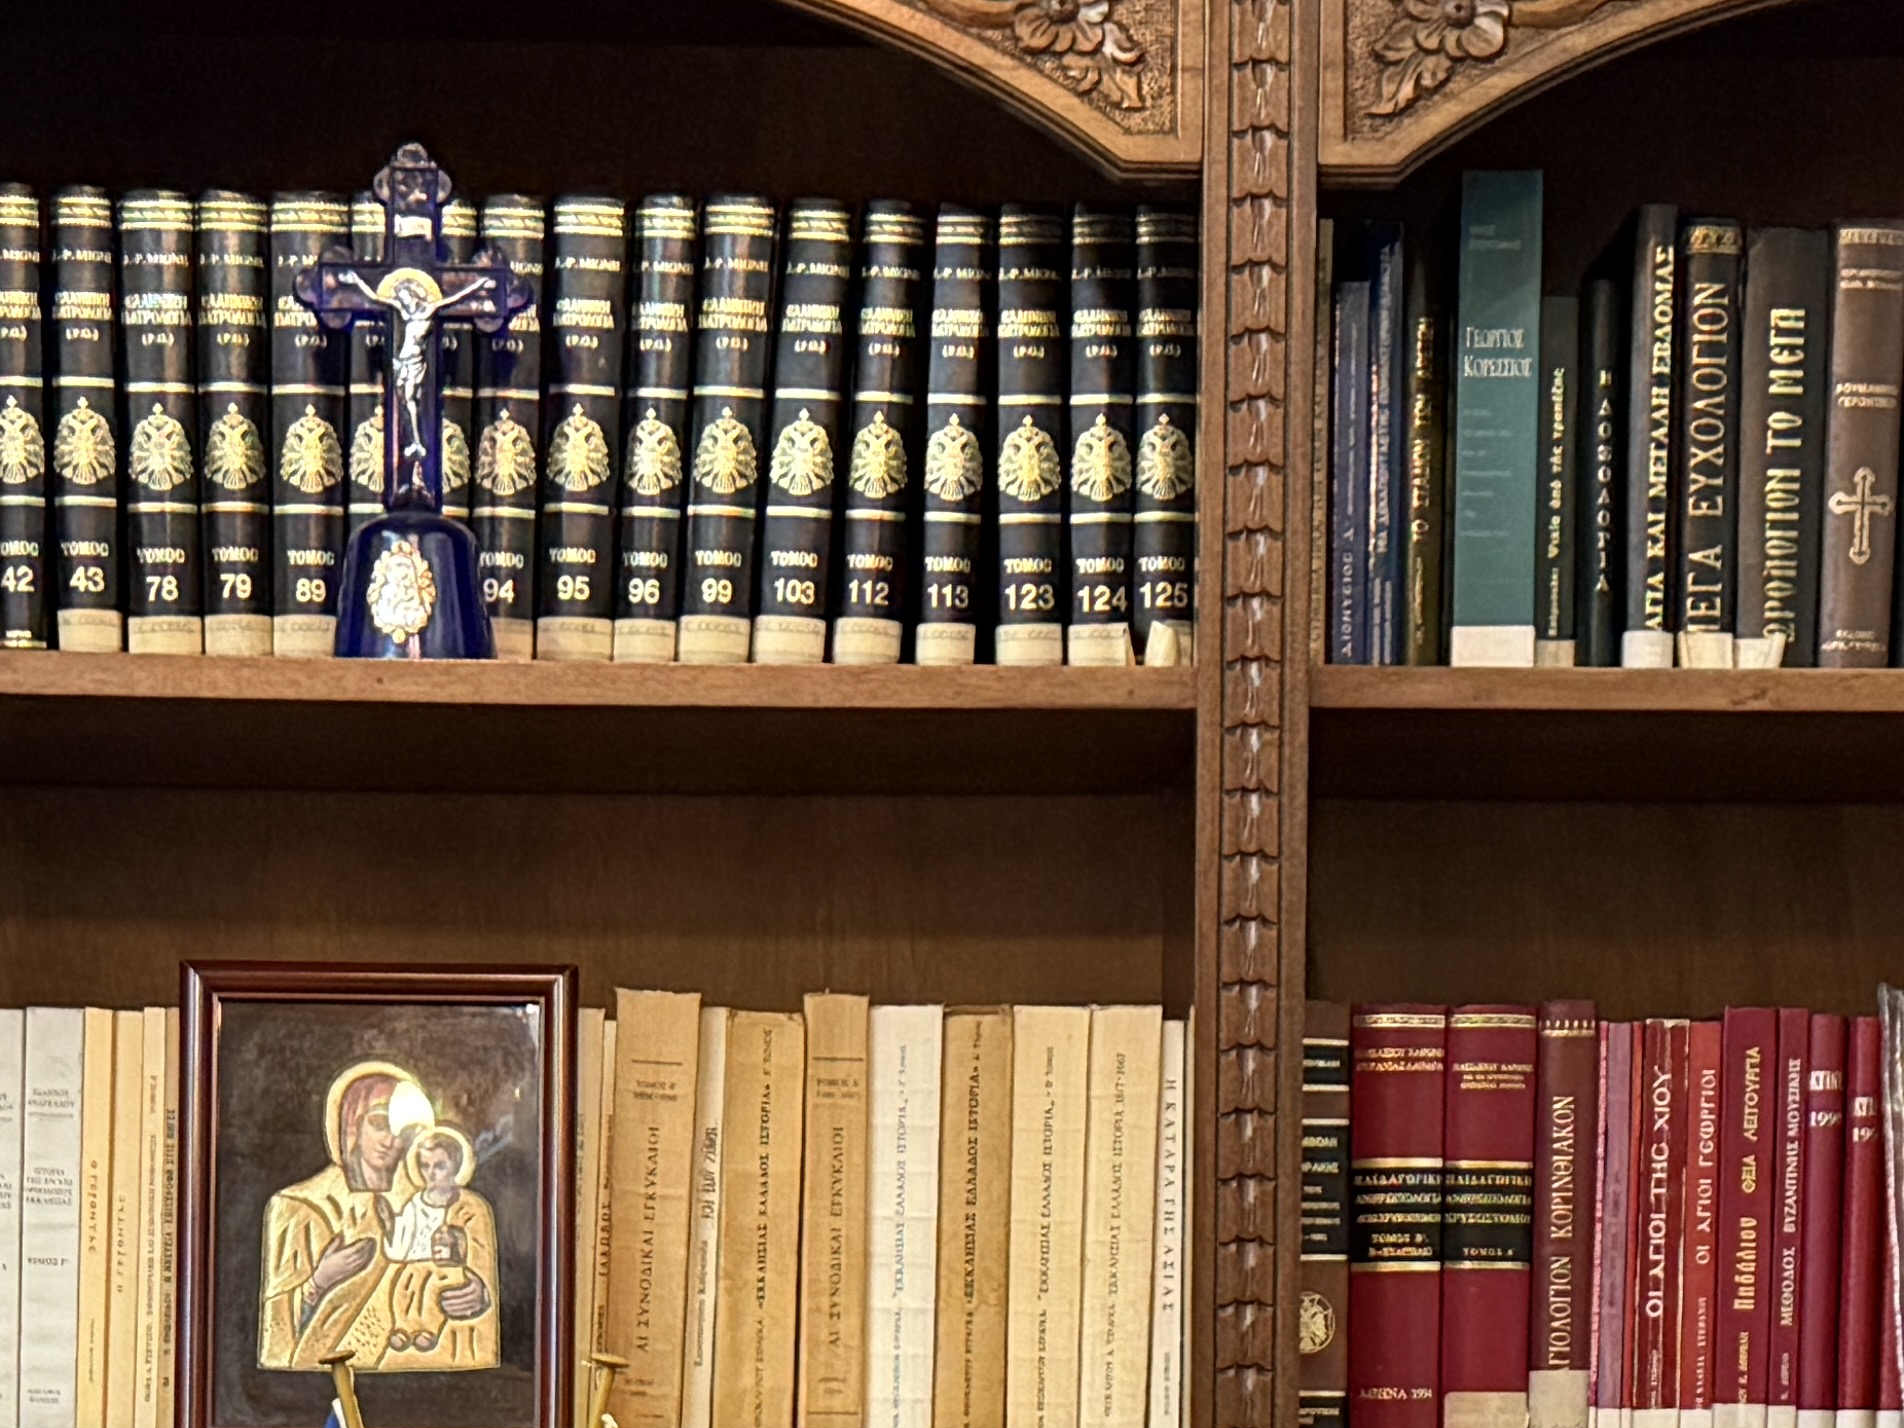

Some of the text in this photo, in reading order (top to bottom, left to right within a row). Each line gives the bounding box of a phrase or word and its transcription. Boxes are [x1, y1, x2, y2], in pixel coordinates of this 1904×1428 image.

[1688, 282, 1728, 517] ΕΥΧΟΛΟΓΙΟΝ
[1645, 246, 1674, 629] ΑΓΙΑ ΚΑΙ ΜΕΓΑΛΗ ΕΒΔΟΜΑΣ
[1765, 411, 1801, 453] ΤΟ
[0, 567, 34, 592] 42
[70, 567, 105, 592] 43
[146, 576, 179, 601] 78
[221, 574, 252, 600] 79
[296, 578, 326, 602] 89
[483, 578, 514, 603] 94
[557, 575, 590, 600] 95
[628, 578, 660, 603] 96
[702, 578, 732, 603] 99
[774, 579, 815, 604] 103
[849, 581, 889, 605] 112
[927, 583, 969, 608] 113
[1005, 584, 1054, 611] 123
[1077, 584, 1128, 612] 124
[1139, 582, 1188, 608] 125
[1653, 1065, 1672, 1131] ΧΙΟΥ
[1742, 1047, 1760, 1193] ΘΕΙΑ ΛΕΙΤΟΥΡΓΙΑ
[965, 1137, 979, 1206] ΕΛΛΑΔΟΣ
[1550, 1097, 1574, 1239] ΚΟΡΙΝΘΙΑΚΟΝ
[758, 1152, 770, 1217] ΕΛΛΑΔΟΣ
[1779, 1059, 1801, 1327] ΜΕΘΟΔΟΣ ΒΥΖΑΝΤΙΝΗΣ ΜΟΥΣΙΚΗΣ
[1697, 1179, 1712, 1233] ΑΓΙΟΙ
[1648, 1212, 1666, 1279] ΑΓΙΟΙ
[1696, 1246, 1711, 1264] ΟΙ
[637, 1230, 654, 1328] ΣΥΝΟΔΙΚΑΙ
[828, 1227, 842, 1321] ΣΥΝΟΔΙΚΑΙ
[1645, 1291, 1663, 1317] ΟΙ
